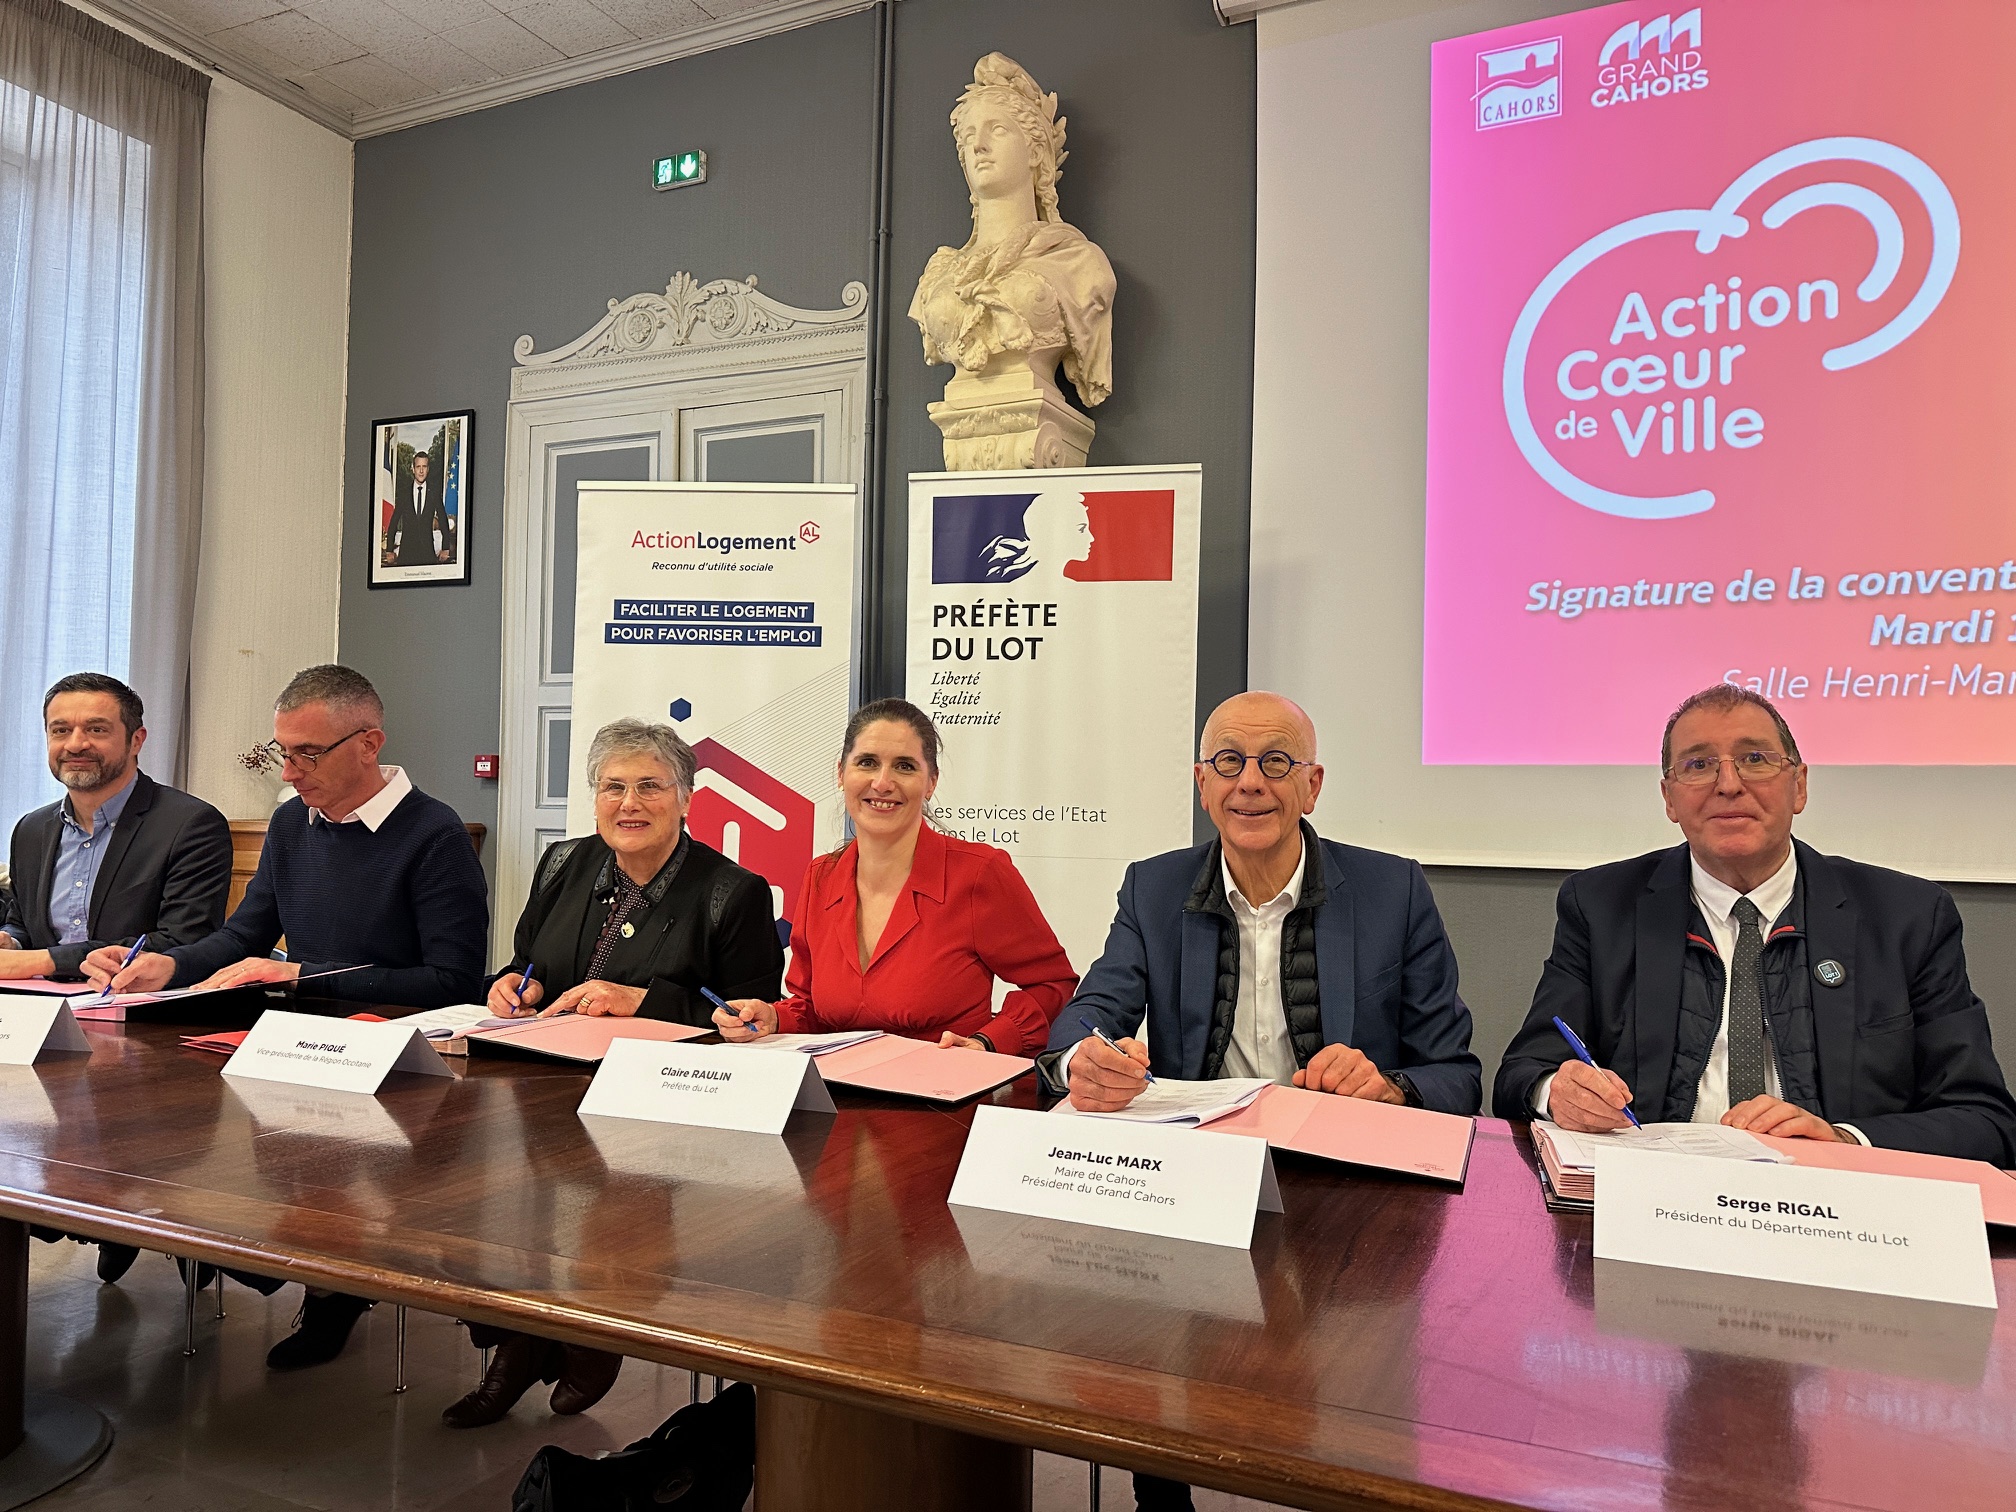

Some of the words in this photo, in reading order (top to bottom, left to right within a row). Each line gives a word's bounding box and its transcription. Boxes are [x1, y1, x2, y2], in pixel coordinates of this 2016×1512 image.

[1598, 51, 1702, 86] GRAND
[1590, 69, 1709, 108] CAHORS
[1483, 93, 1555, 122] CAHORS
[1609, 276, 1839, 345] Action
[1556, 344, 1746, 401] Cœur
[1555, 410, 1598, 440] de
[1611, 396, 1765, 458] Ville
[651, 561, 696, 571] Reconnu
[698, 562, 737, 572] d'utilité
[739, 562, 774, 572] sociale
[1525, 578, 1715, 619] Signature
[1726, 569, 1776, 602] de
[1788, 567, 1825, 600] la
[1837, 560, 2016, 597] convent
[620, 604, 697, 617] FACILITER
[701, 605, 720, 617] LE
[723, 606, 808, 619] LOGEMENT
[933, 598, 1058, 628] PRÉFÈTE
[611, 627, 654, 640] POUR
[657, 628, 743, 641] FAVORISER
[747, 630, 816, 643] L'EMPLOI
[1870, 609, 1996, 646] Mardi
[932, 637, 975, 661] DU
[986, 636, 1044, 661] LOT
[930, 671, 981, 686] Liberté
[930, 688, 981, 709] Égalité
[930, 711, 1001, 725] Fraternité
[957, 804, 1027, 821] services
[1032, 805, 1055, 822] de
[972, 826, 986, 842] le
[992, 828, 1020, 843] Lot
[295, 1040, 319, 1050] Marie
[319, 1043, 347, 1053] PIQUÉ
[661, 1067, 690, 1078] Claire
[691, 1070, 732, 1082] RAULIN
[661, 1081, 690, 1090] Préfète
[692, 1084, 702, 1092] du
[704, 1085, 719, 1094] Lot
[1048, 1147, 1113, 1165] Jean-Luc
[1116, 1155, 1163, 1172] MARX
[1054, 1166, 1085, 1179] Maire
[1088, 1171, 1103, 1181] de
[1106, 1173, 1147, 1187] Cahors
[1021, 1175, 1074, 1192] Président
[1077, 1183, 1092, 1194] du
[1095, 1186, 1131, 1199] Grand
[1134, 1191, 1176, 1206] Cahors
[1717, 1194, 1772, 1213] Serge
[1777, 1201, 1839, 1220] RIGAL
[1655, 1208, 1724, 1226] Président
[1728, 1217, 1747, 1229] du
[1752, 1219, 1853, 1241] Département
[1857, 1232, 1878, 1244] du
[1883, 1234, 1909, 1247] Lot
